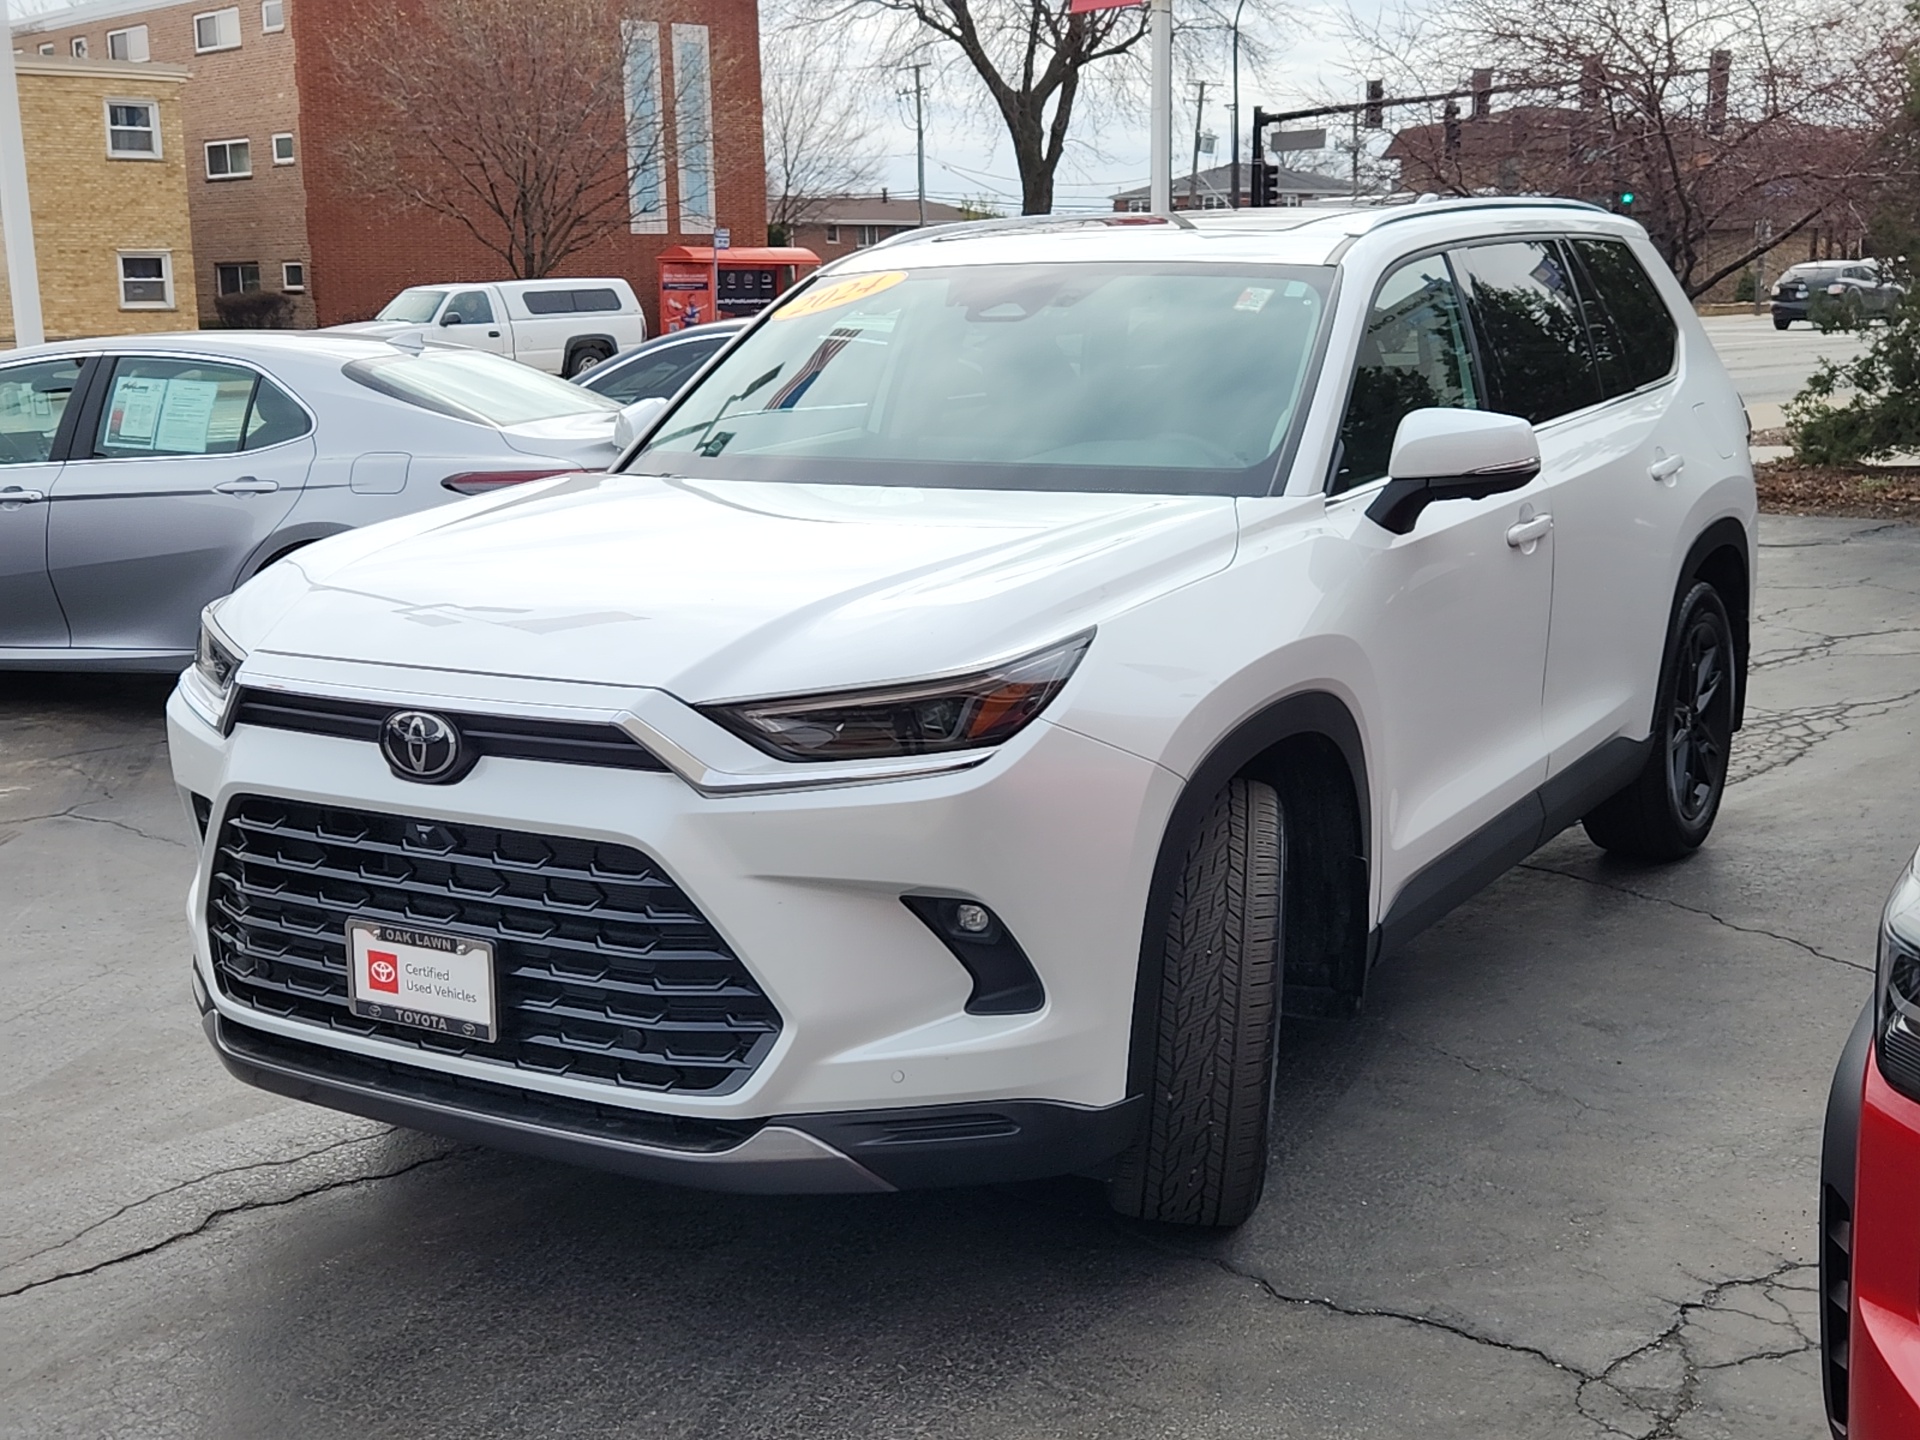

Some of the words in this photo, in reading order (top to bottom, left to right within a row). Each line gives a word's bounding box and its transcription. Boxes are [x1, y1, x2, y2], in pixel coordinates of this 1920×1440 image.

[788, 274, 888, 316] 2024
[385, 928, 413, 944] OAK
[415, 934, 452, 950] LAWN
[405, 963, 450, 981] Certified
[406, 979, 432, 995] Used
[433, 985, 477, 1003] Vehicles
[394, 1008, 448, 1030] TOYOTA
